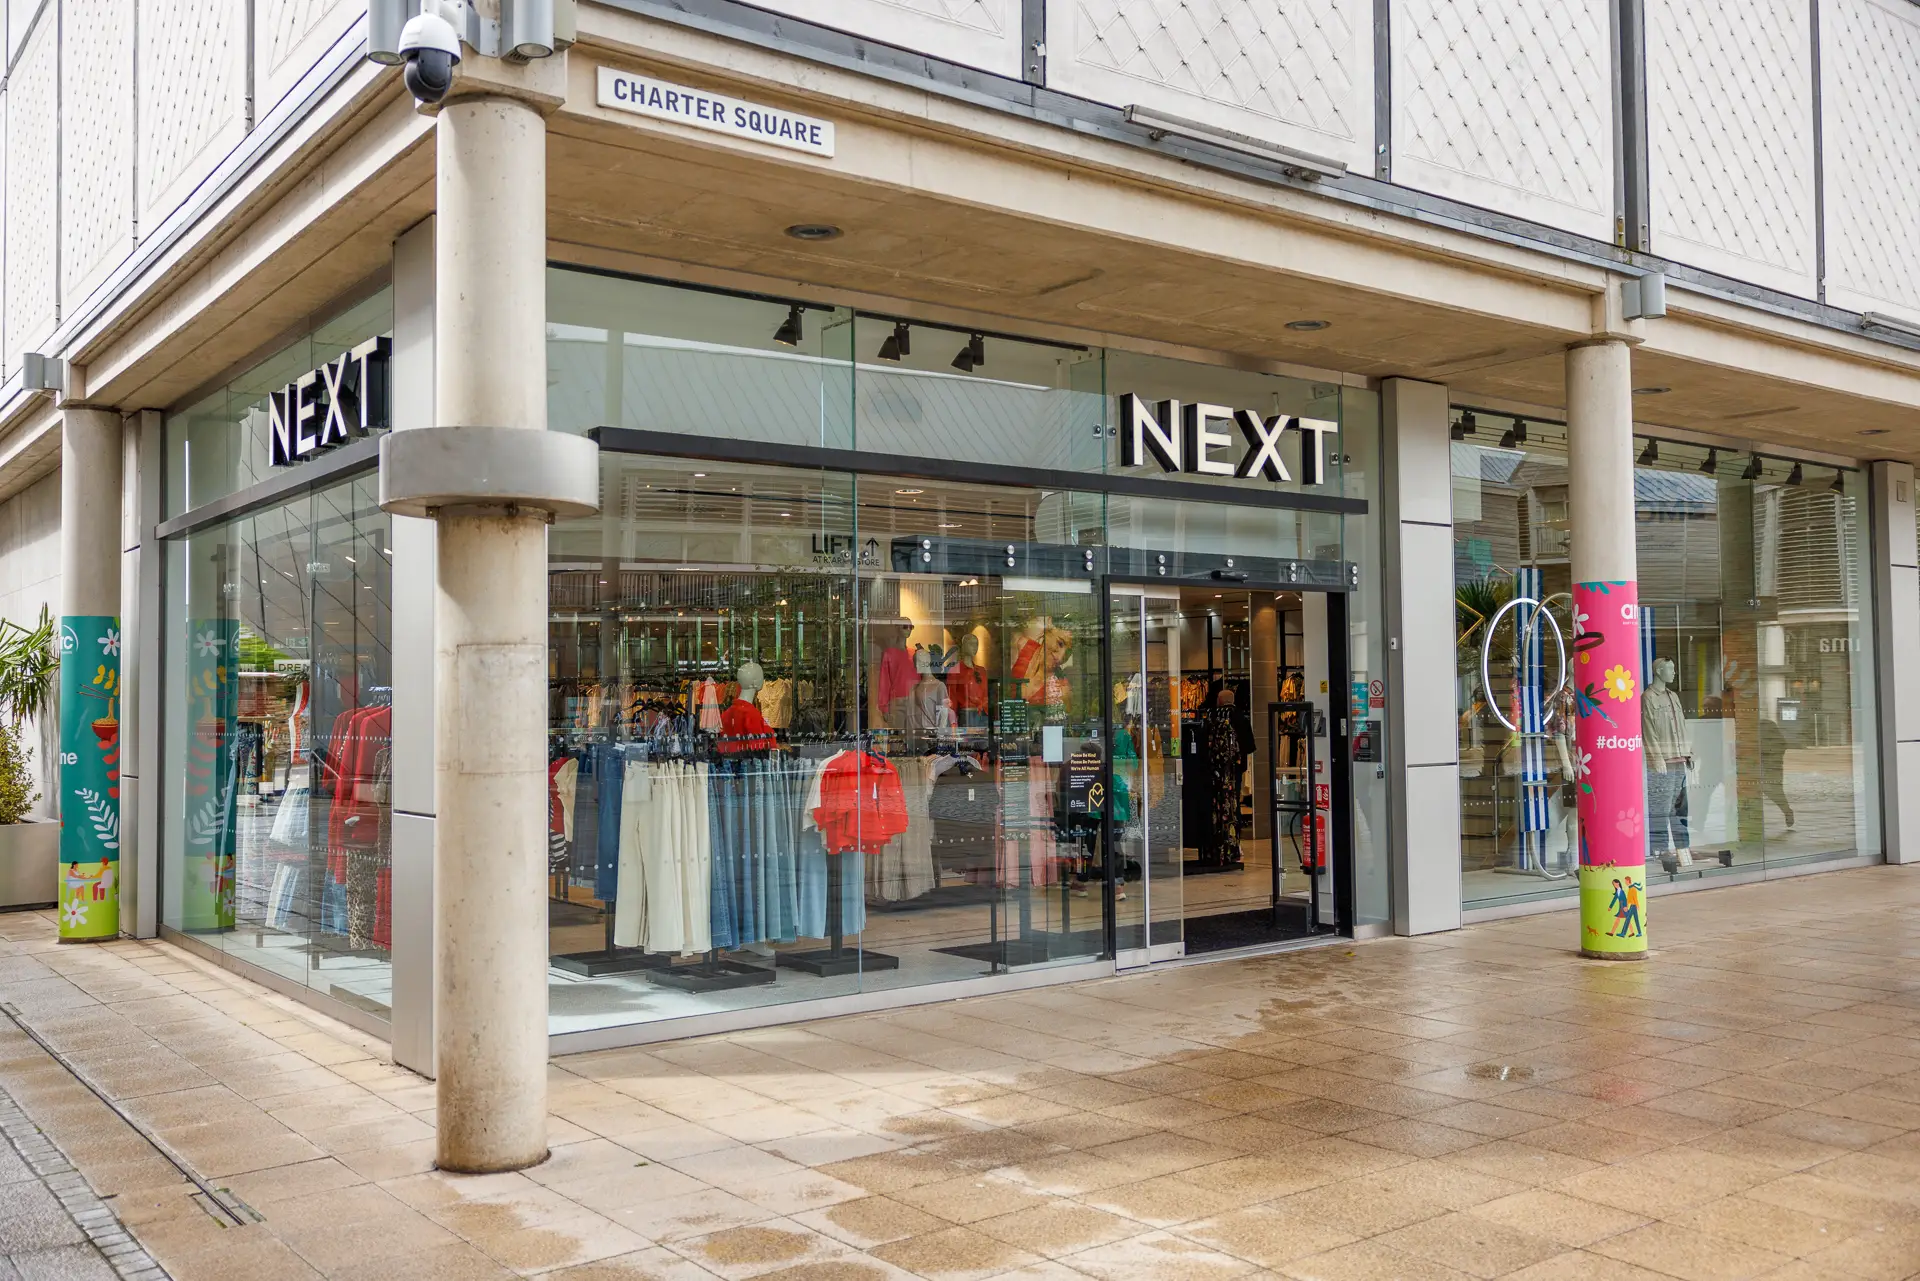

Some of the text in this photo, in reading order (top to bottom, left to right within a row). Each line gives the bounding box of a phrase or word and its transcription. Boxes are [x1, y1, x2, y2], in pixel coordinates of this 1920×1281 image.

[613, 78, 823, 146] CHARTER SQUARE
[268, 336, 382, 467] NEXT
[1126, 392, 1338, 485] NEXT
[812, 533, 854, 554] LIFT
[274, 663, 310, 673] DREN
